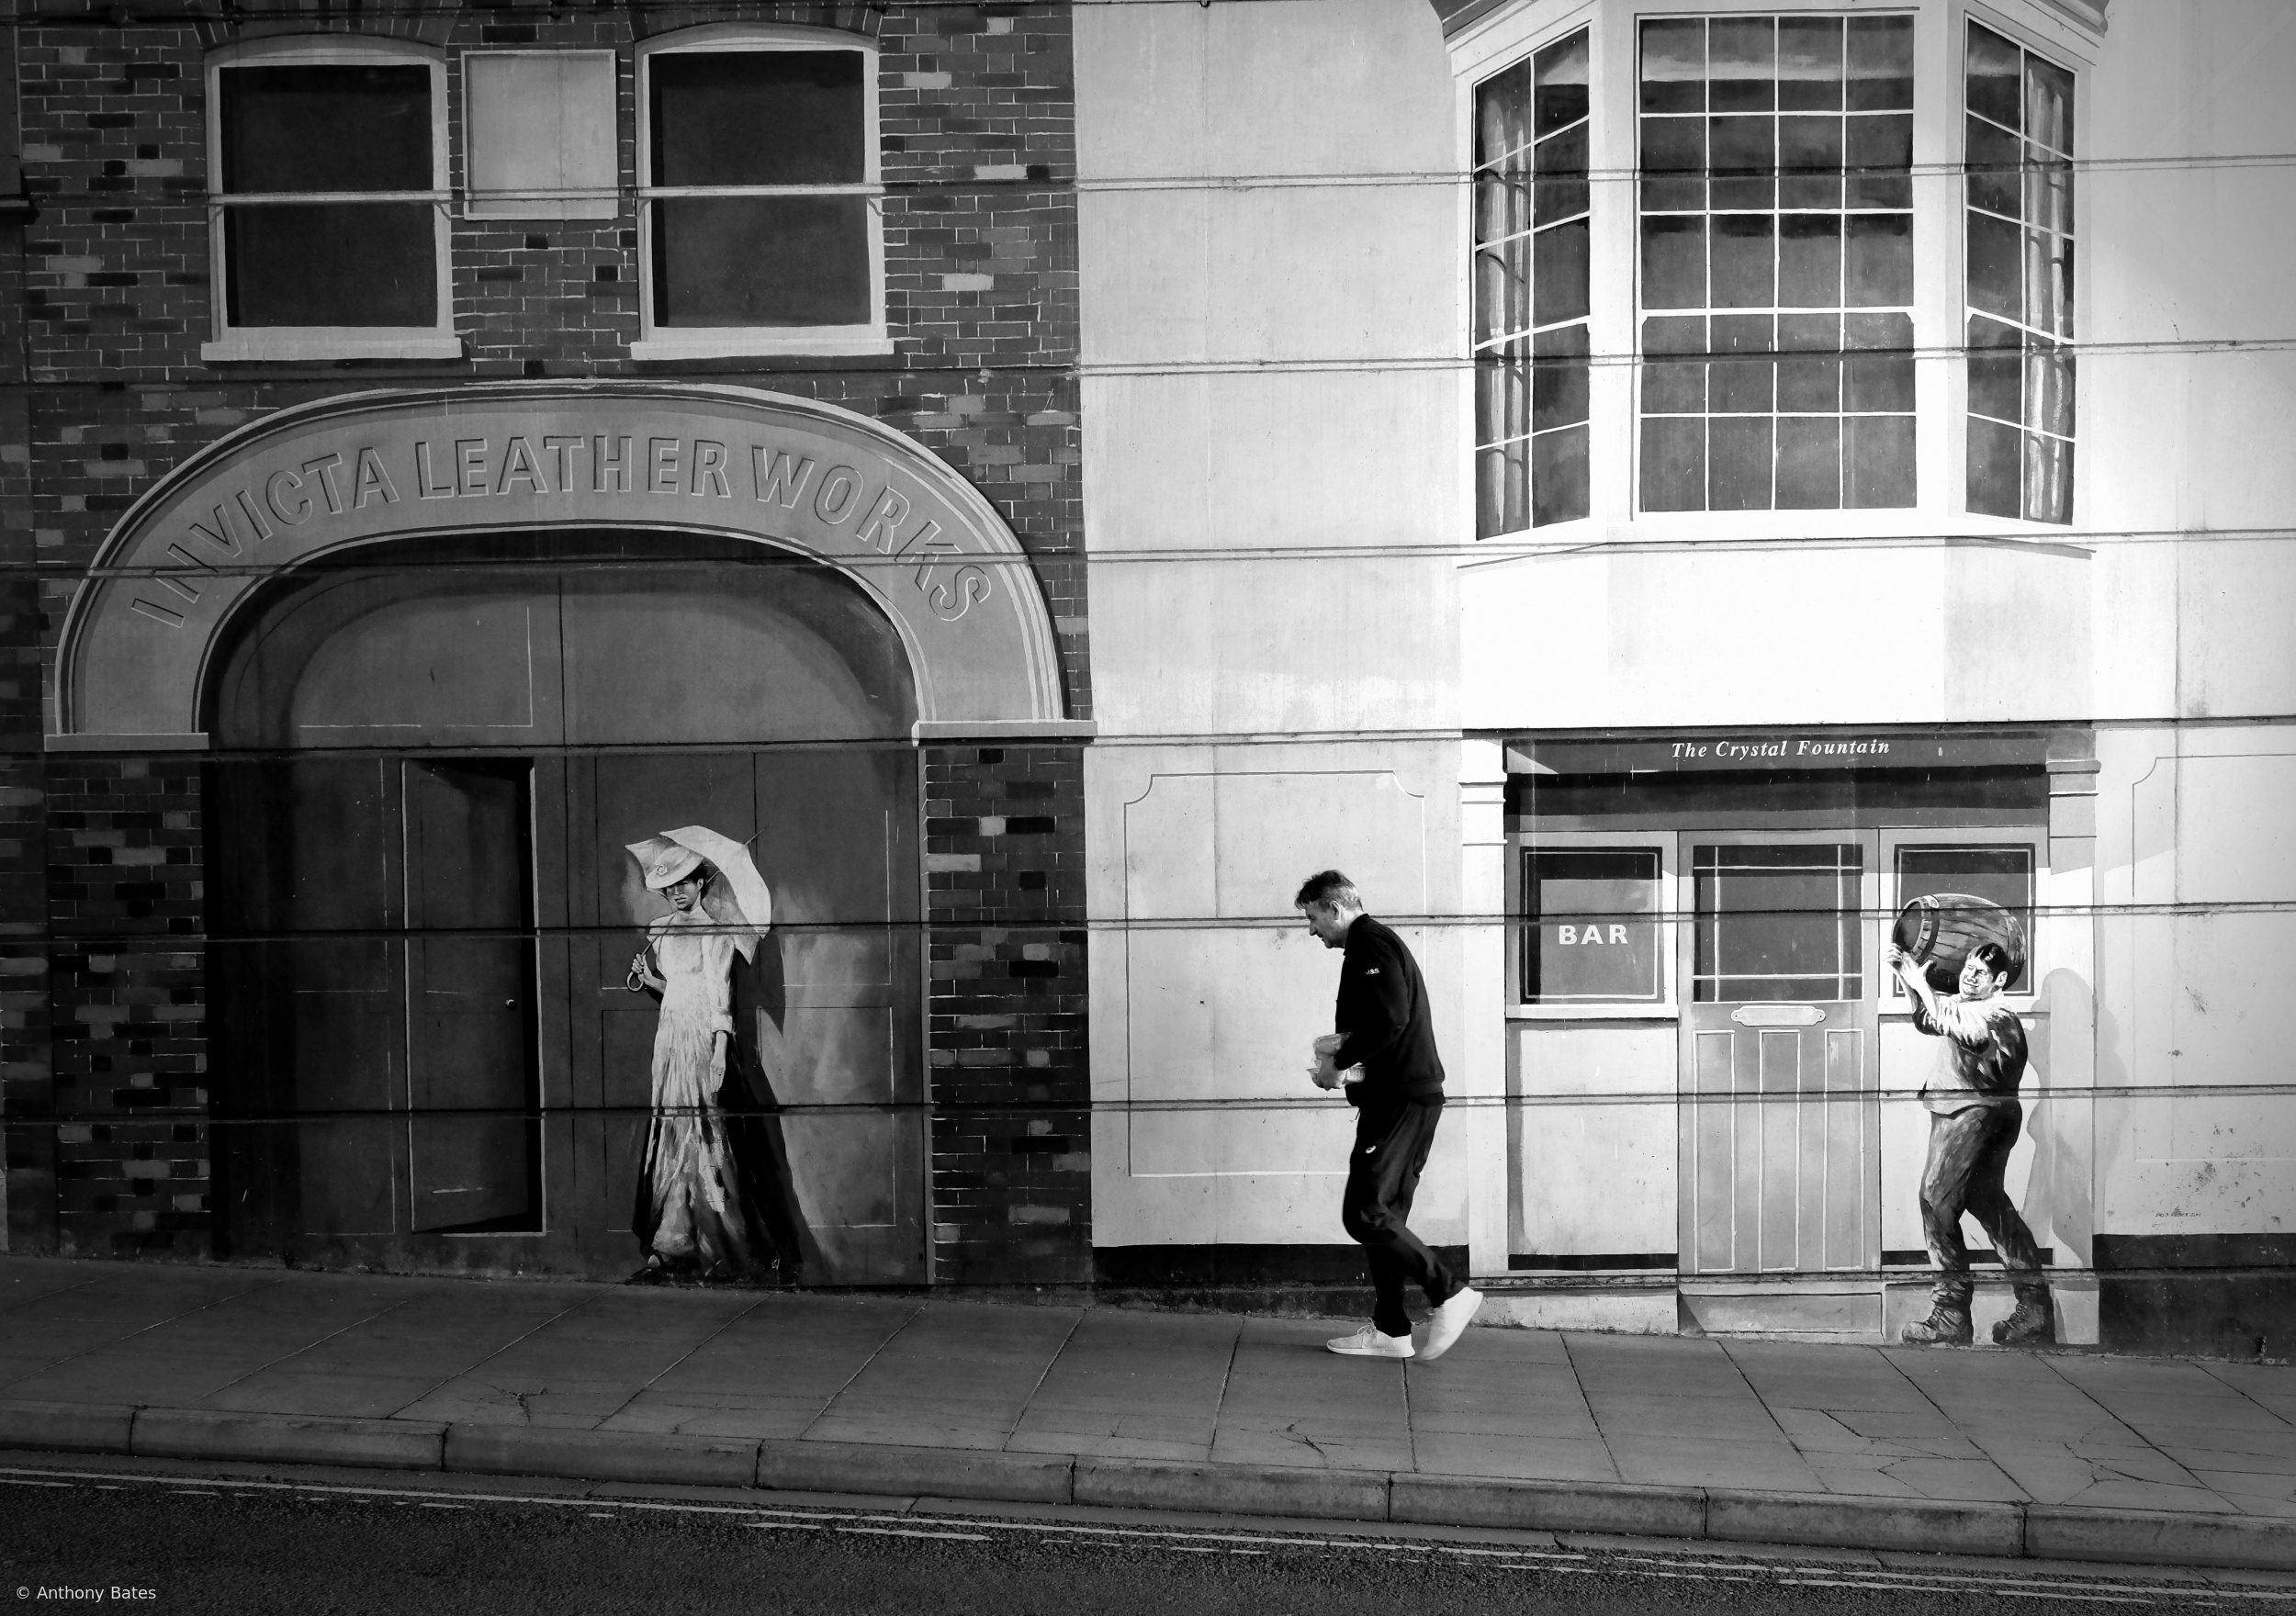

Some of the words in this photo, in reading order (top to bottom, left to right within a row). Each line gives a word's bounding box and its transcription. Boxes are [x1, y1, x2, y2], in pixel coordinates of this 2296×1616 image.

[130, 446, 400, 629] INVICTA
[417, 434, 731, 500] LEATHER
[751, 444, 992, 622] WORKS
[1671, 742, 1708, 758] The
[1716, 740, 1788, 761] Crystal
[1796, 738, 1891, 757] Fountain
[1558, 924, 1629, 946] BAR
